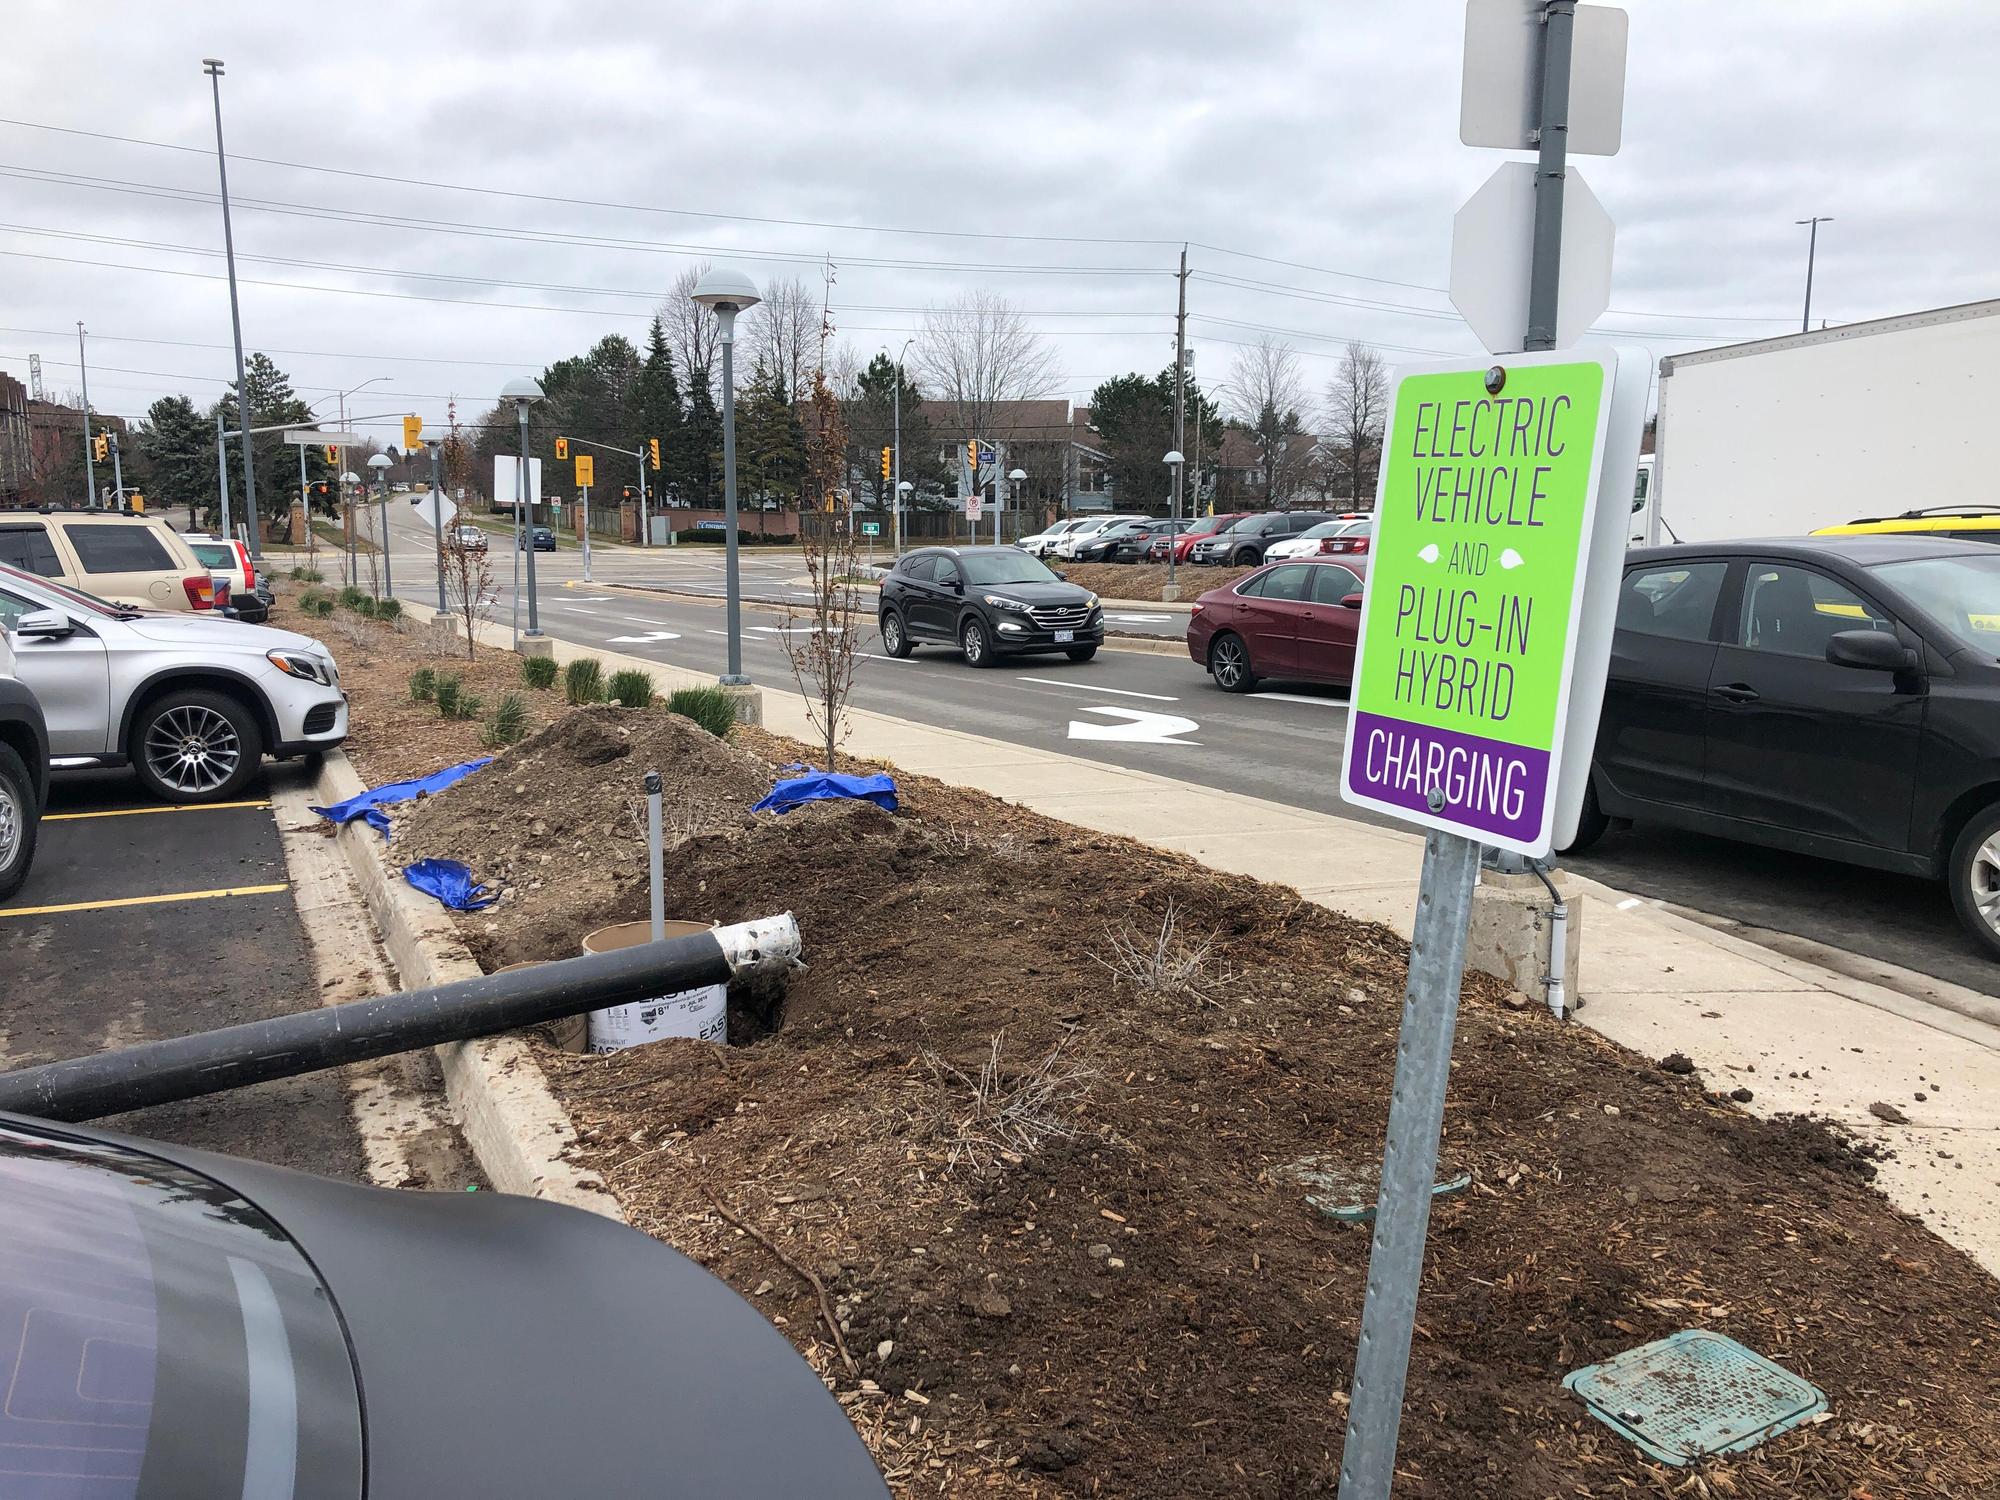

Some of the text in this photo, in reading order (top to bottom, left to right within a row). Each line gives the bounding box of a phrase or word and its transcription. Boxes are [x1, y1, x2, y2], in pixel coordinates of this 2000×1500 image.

[1413, 395, 1570, 457] ELECTRIC
[1416, 467, 1552, 526] VEHICLE
[1447, 542, 1489, 576] AND
[1396, 585, 1533, 656] PLUG-IN
[1394, 648, 1515, 721] HYBRID
[1366, 728, 1527, 820] CHARGING
